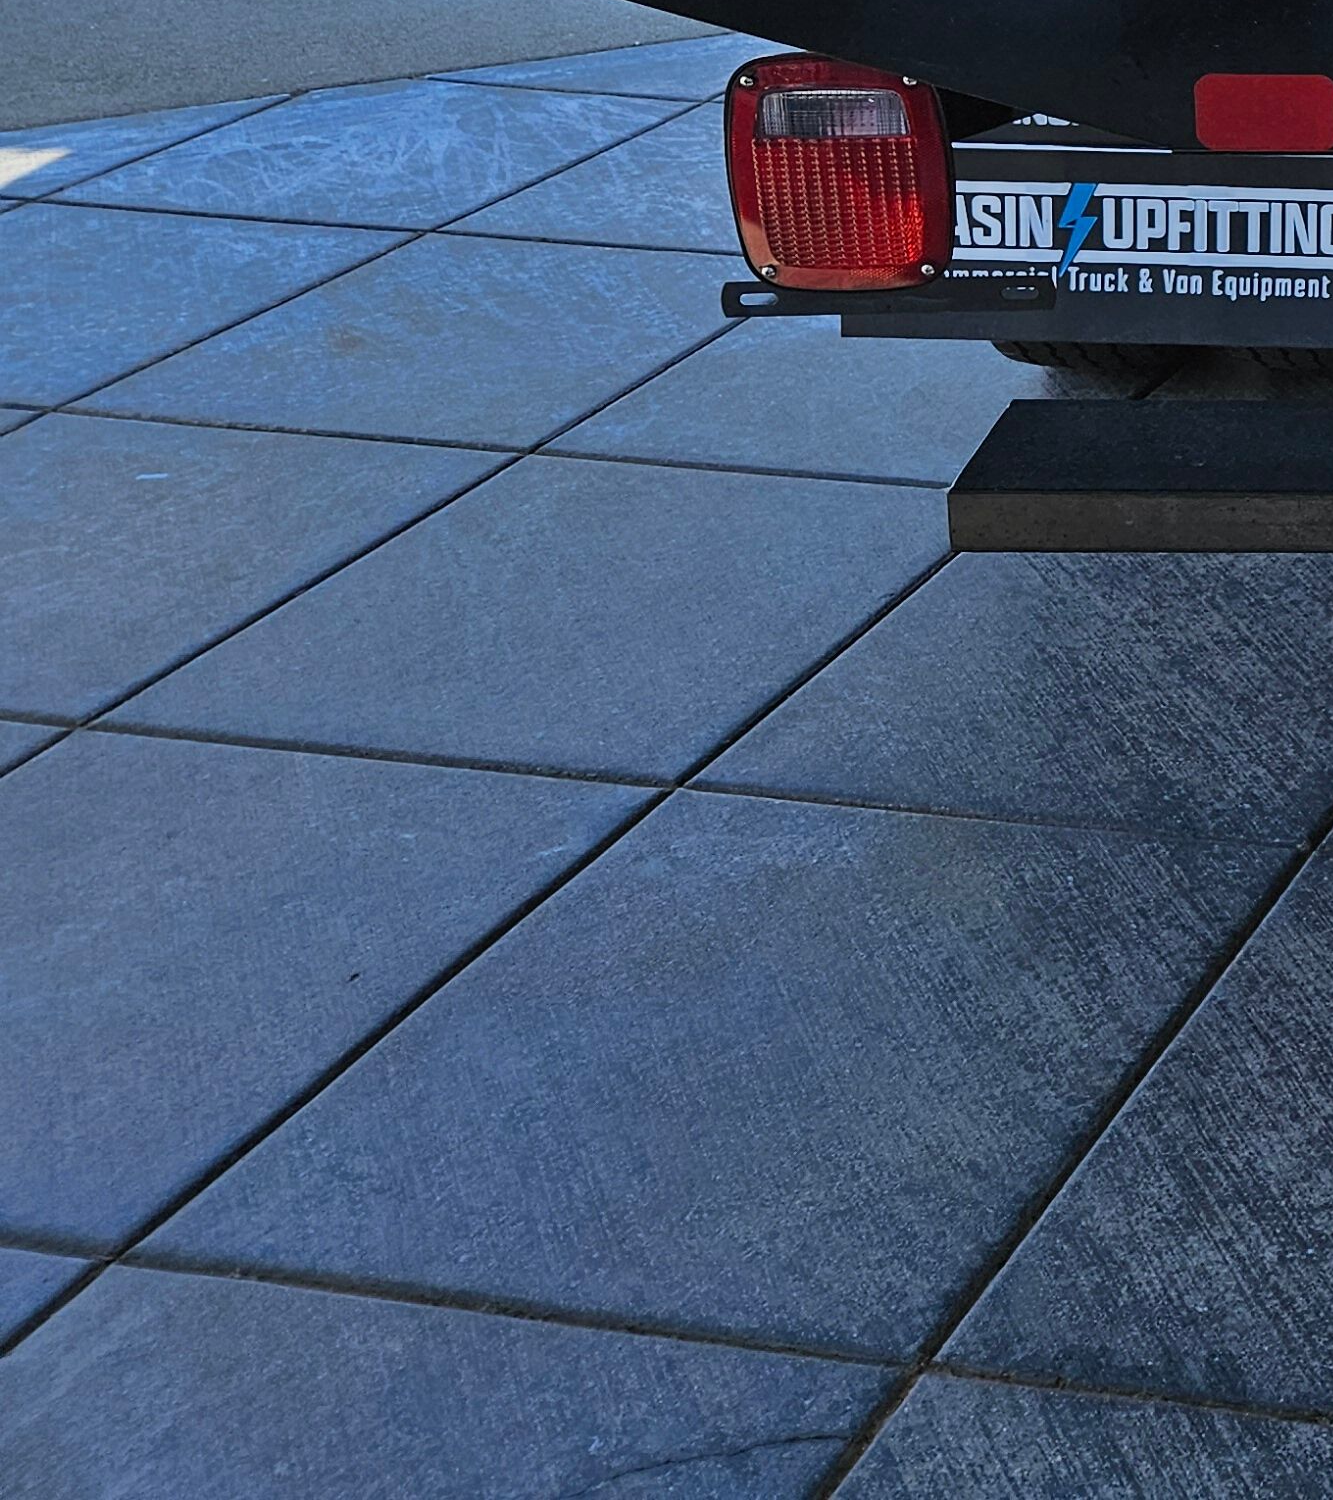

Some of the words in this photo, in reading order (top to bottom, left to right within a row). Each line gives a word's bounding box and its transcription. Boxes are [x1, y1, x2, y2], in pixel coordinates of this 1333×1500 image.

[955, 194, 1053, 248] ASIN
[1067, 266, 1129, 293] Truck
[1139, 268, 1153, 293] &
[1163, 270, 1203, 295] Van
[1212, 270, 1331, 301] Equipment
